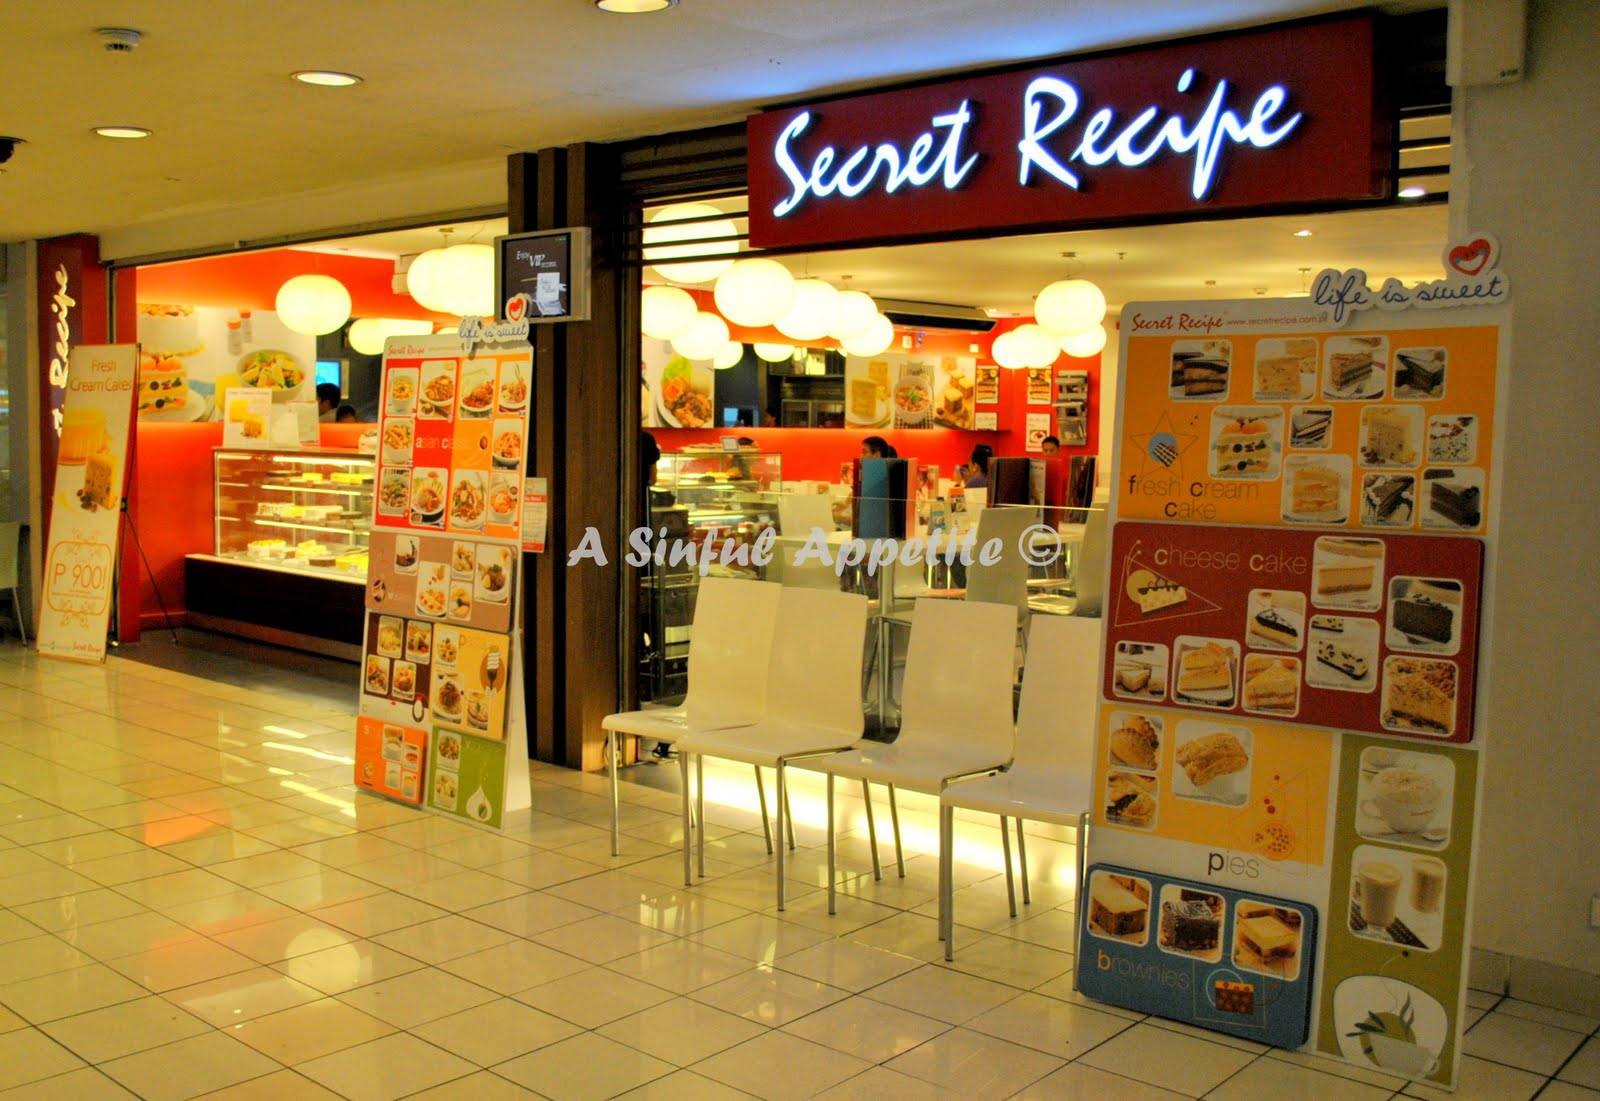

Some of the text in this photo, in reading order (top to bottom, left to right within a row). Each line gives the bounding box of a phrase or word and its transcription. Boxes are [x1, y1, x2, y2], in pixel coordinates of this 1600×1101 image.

[772, 67, 1303, 218] Secret Recipe
[529, 254, 546, 267] VIP
[1314, 275, 1503, 322] life is sweet
[49, 263, 76, 389] Recipe
[459, 319, 479, 349] life
[497, 324, 527, 337] sweet
[1131, 313, 1174, 332] Secret
[1178, 313, 1223, 333] Recipe
[91, 360, 117, 373] Fresh
[70, 379, 104, 392] Cream
[1128, 475, 1259, 499] fresh cream
[1164, 500, 1217, 519] cake
[1153, 544, 1308, 575] cheese cake
[53, 563, 67, 584] P
[1207, 850, 1260, 878] pies
[1096, 948, 1191, 992] brownies
